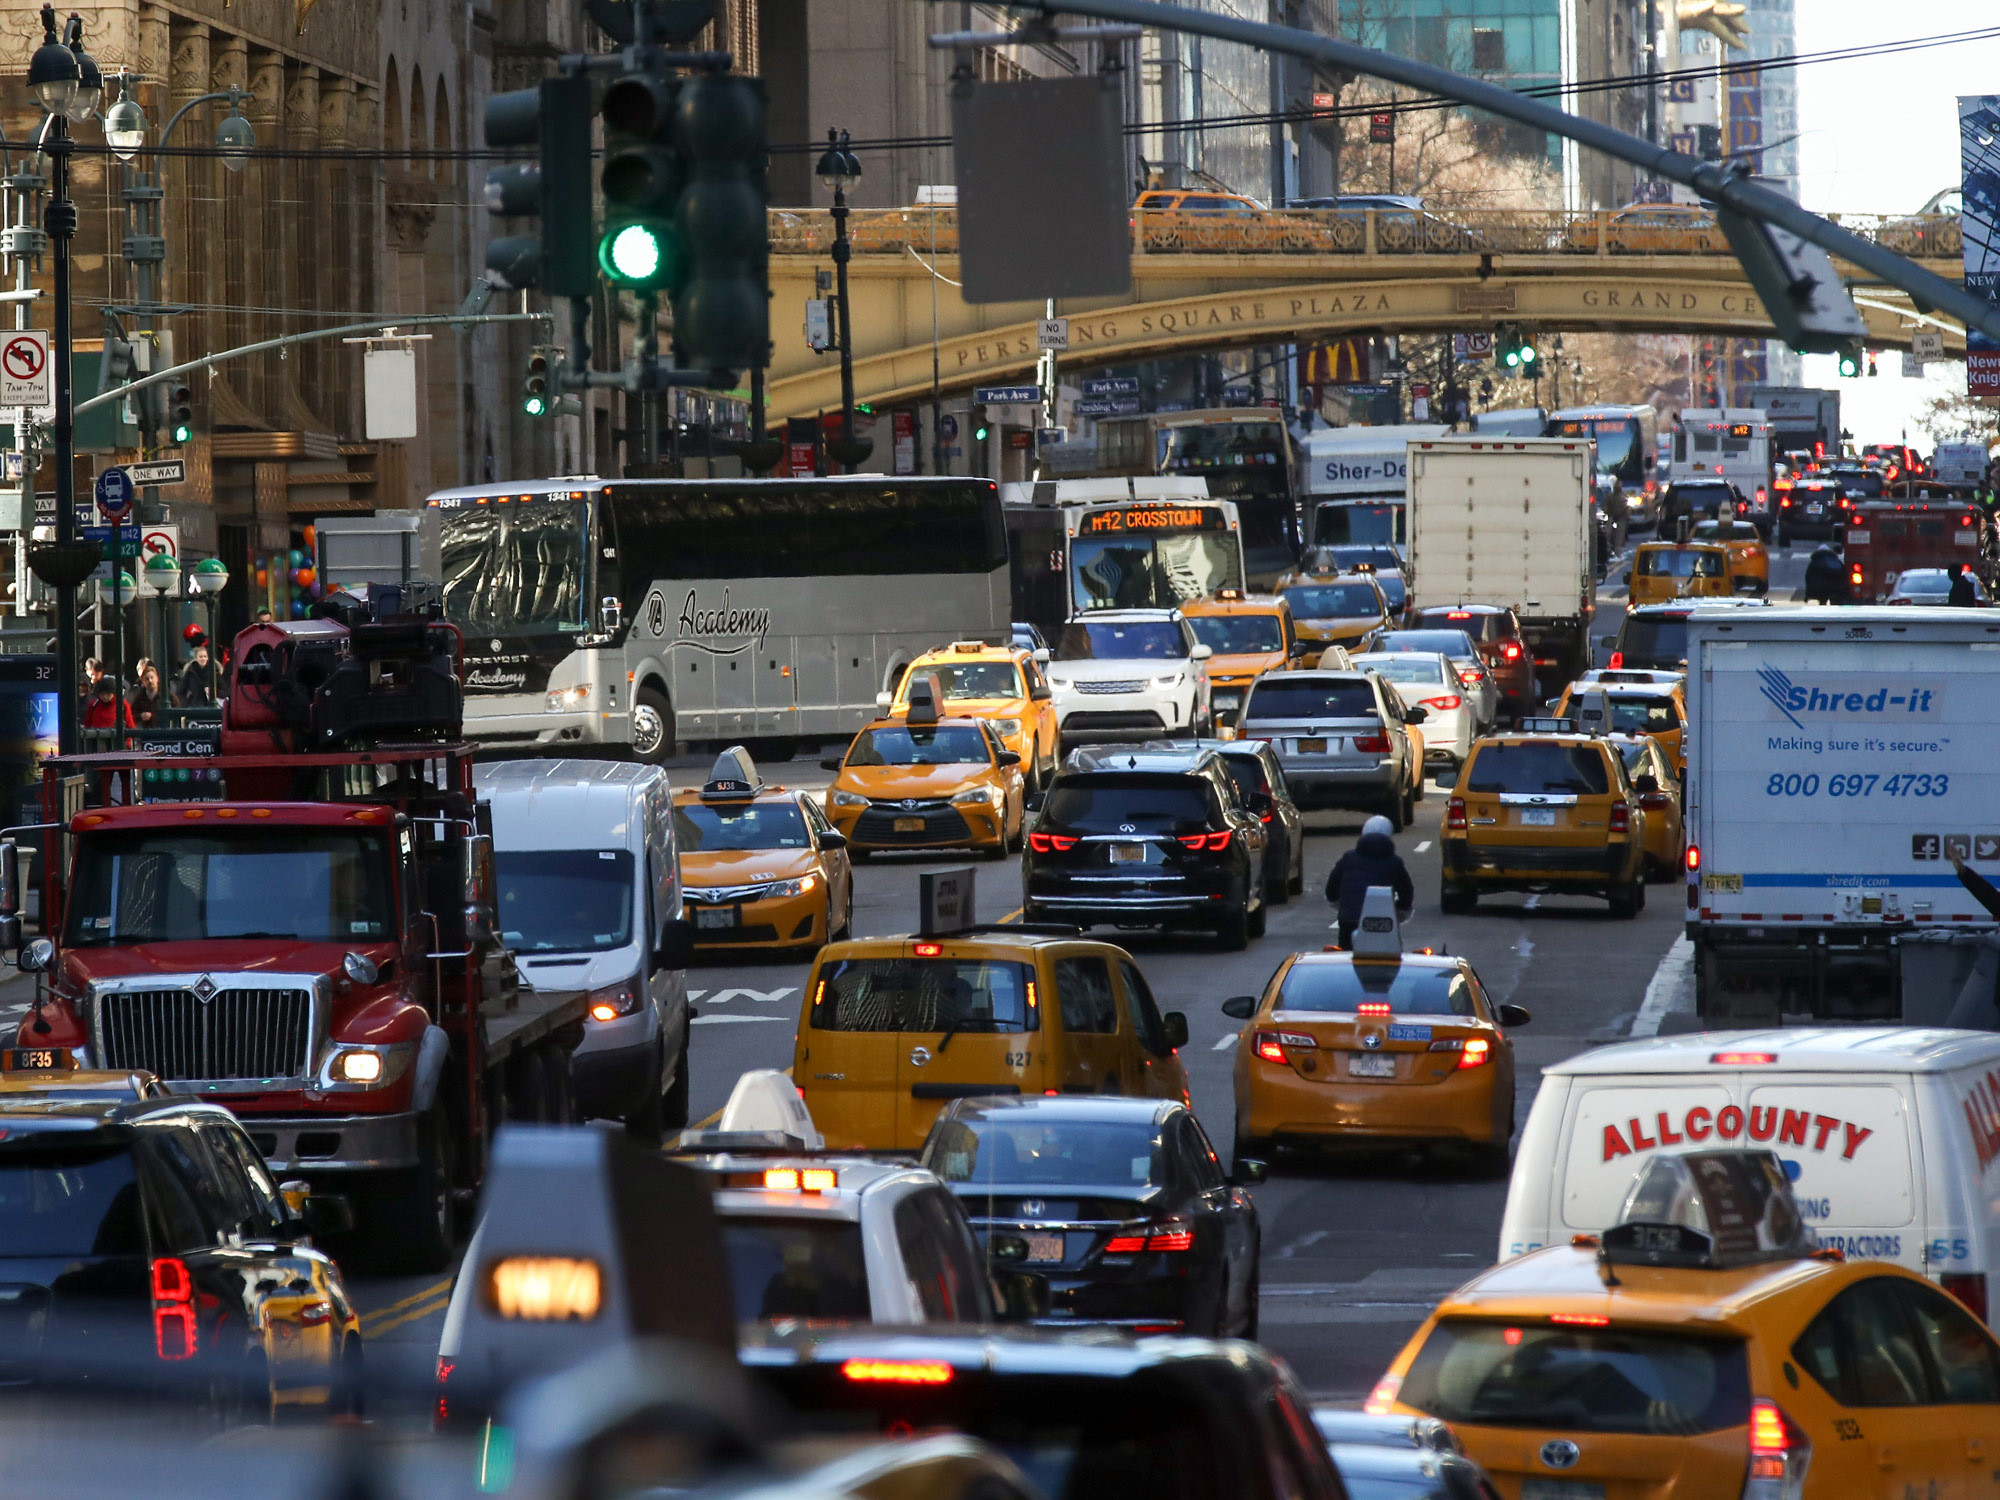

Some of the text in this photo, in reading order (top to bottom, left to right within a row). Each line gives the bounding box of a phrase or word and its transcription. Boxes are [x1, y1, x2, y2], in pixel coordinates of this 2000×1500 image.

[1967, 276, 1996, 286] NEW
[1583, 290, 1697, 309] GRAND
[958, 294, 1390, 365] PERSNG SQUARE PLAZA
[1046, 323, 1059, 334] NO
[1039, 336, 1066, 345] TURNS
[1921, 338, 1935, 347] NO
[1968, 355, 2000, 368] New
[1969, 371, 2000, 386] Knig
[5, 382, 44, 392] 7AM-7PM
[1092, 382, 1130, 392] Park Ave
[987, 389, 1030, 400] Park Ave
[133, 467, 178, 480] ONE WAY
[547, 492, 571, 502] 1341
[439, 499, 462, 509] 1341
[1126, 510, 1203, 528] CROSSTOWN
[121, 528, 138, 539] M42
[679, 586, 770, 653] Academy
[463, 654, 530, 666] PREVOST
[466, 667, 527, 688] Academy
[1785, 685, 1933, 712] Shred-it
[143, 742, 182, 754] Grand
[1767, 737, 1823, 754] Making
[1828, 739, 1860, 751] sure
[1864, 738, 1885, 751] it's
[716, 781, 735, 791] 6J38
[1766, 773, 1950, 797] 800 697 4733
[1826, 875, 1890, 887] shredit.com
[22, 1051, 53, 1068] 8F35
[1005, 1052, 1033, 1067] 627
[1602, 1105, 1874, 1162] ALLCOUNTY
[1931, 1238, 1970, 1260] 55
